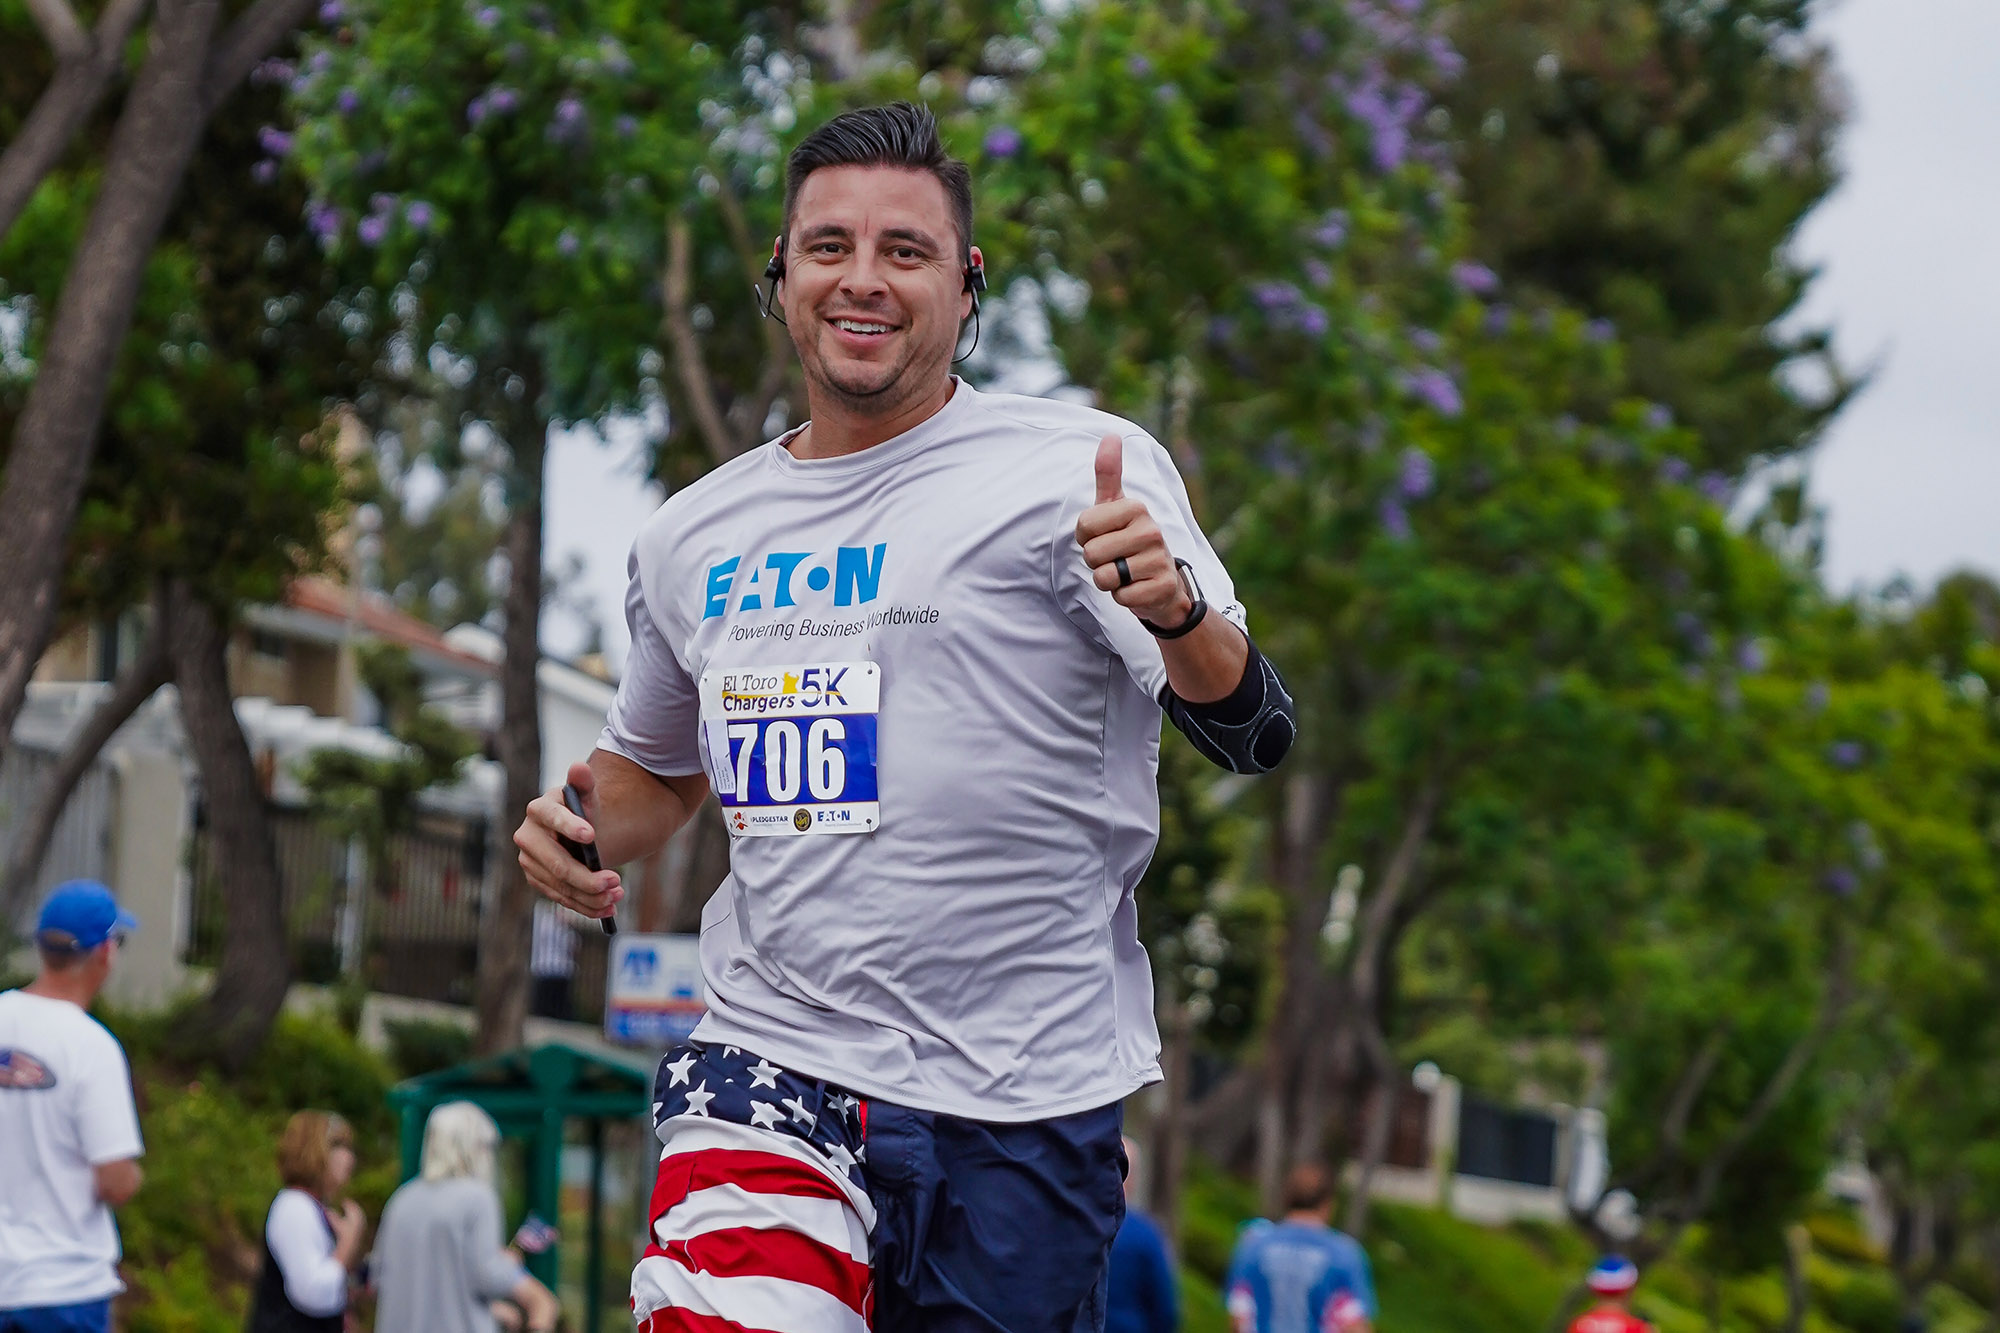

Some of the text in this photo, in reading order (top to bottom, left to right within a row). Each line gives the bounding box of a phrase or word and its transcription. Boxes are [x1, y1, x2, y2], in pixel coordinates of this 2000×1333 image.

[701, 542, 887, 622] EATON
[728, 605, 939, 642] Powering Business Worldwide
[722, 674, 778, 692] El Toro
[801, 666, 850, 708] 5K
[723, 694, 795, 713] Chargers
[727, 717, 846, 803] 706
